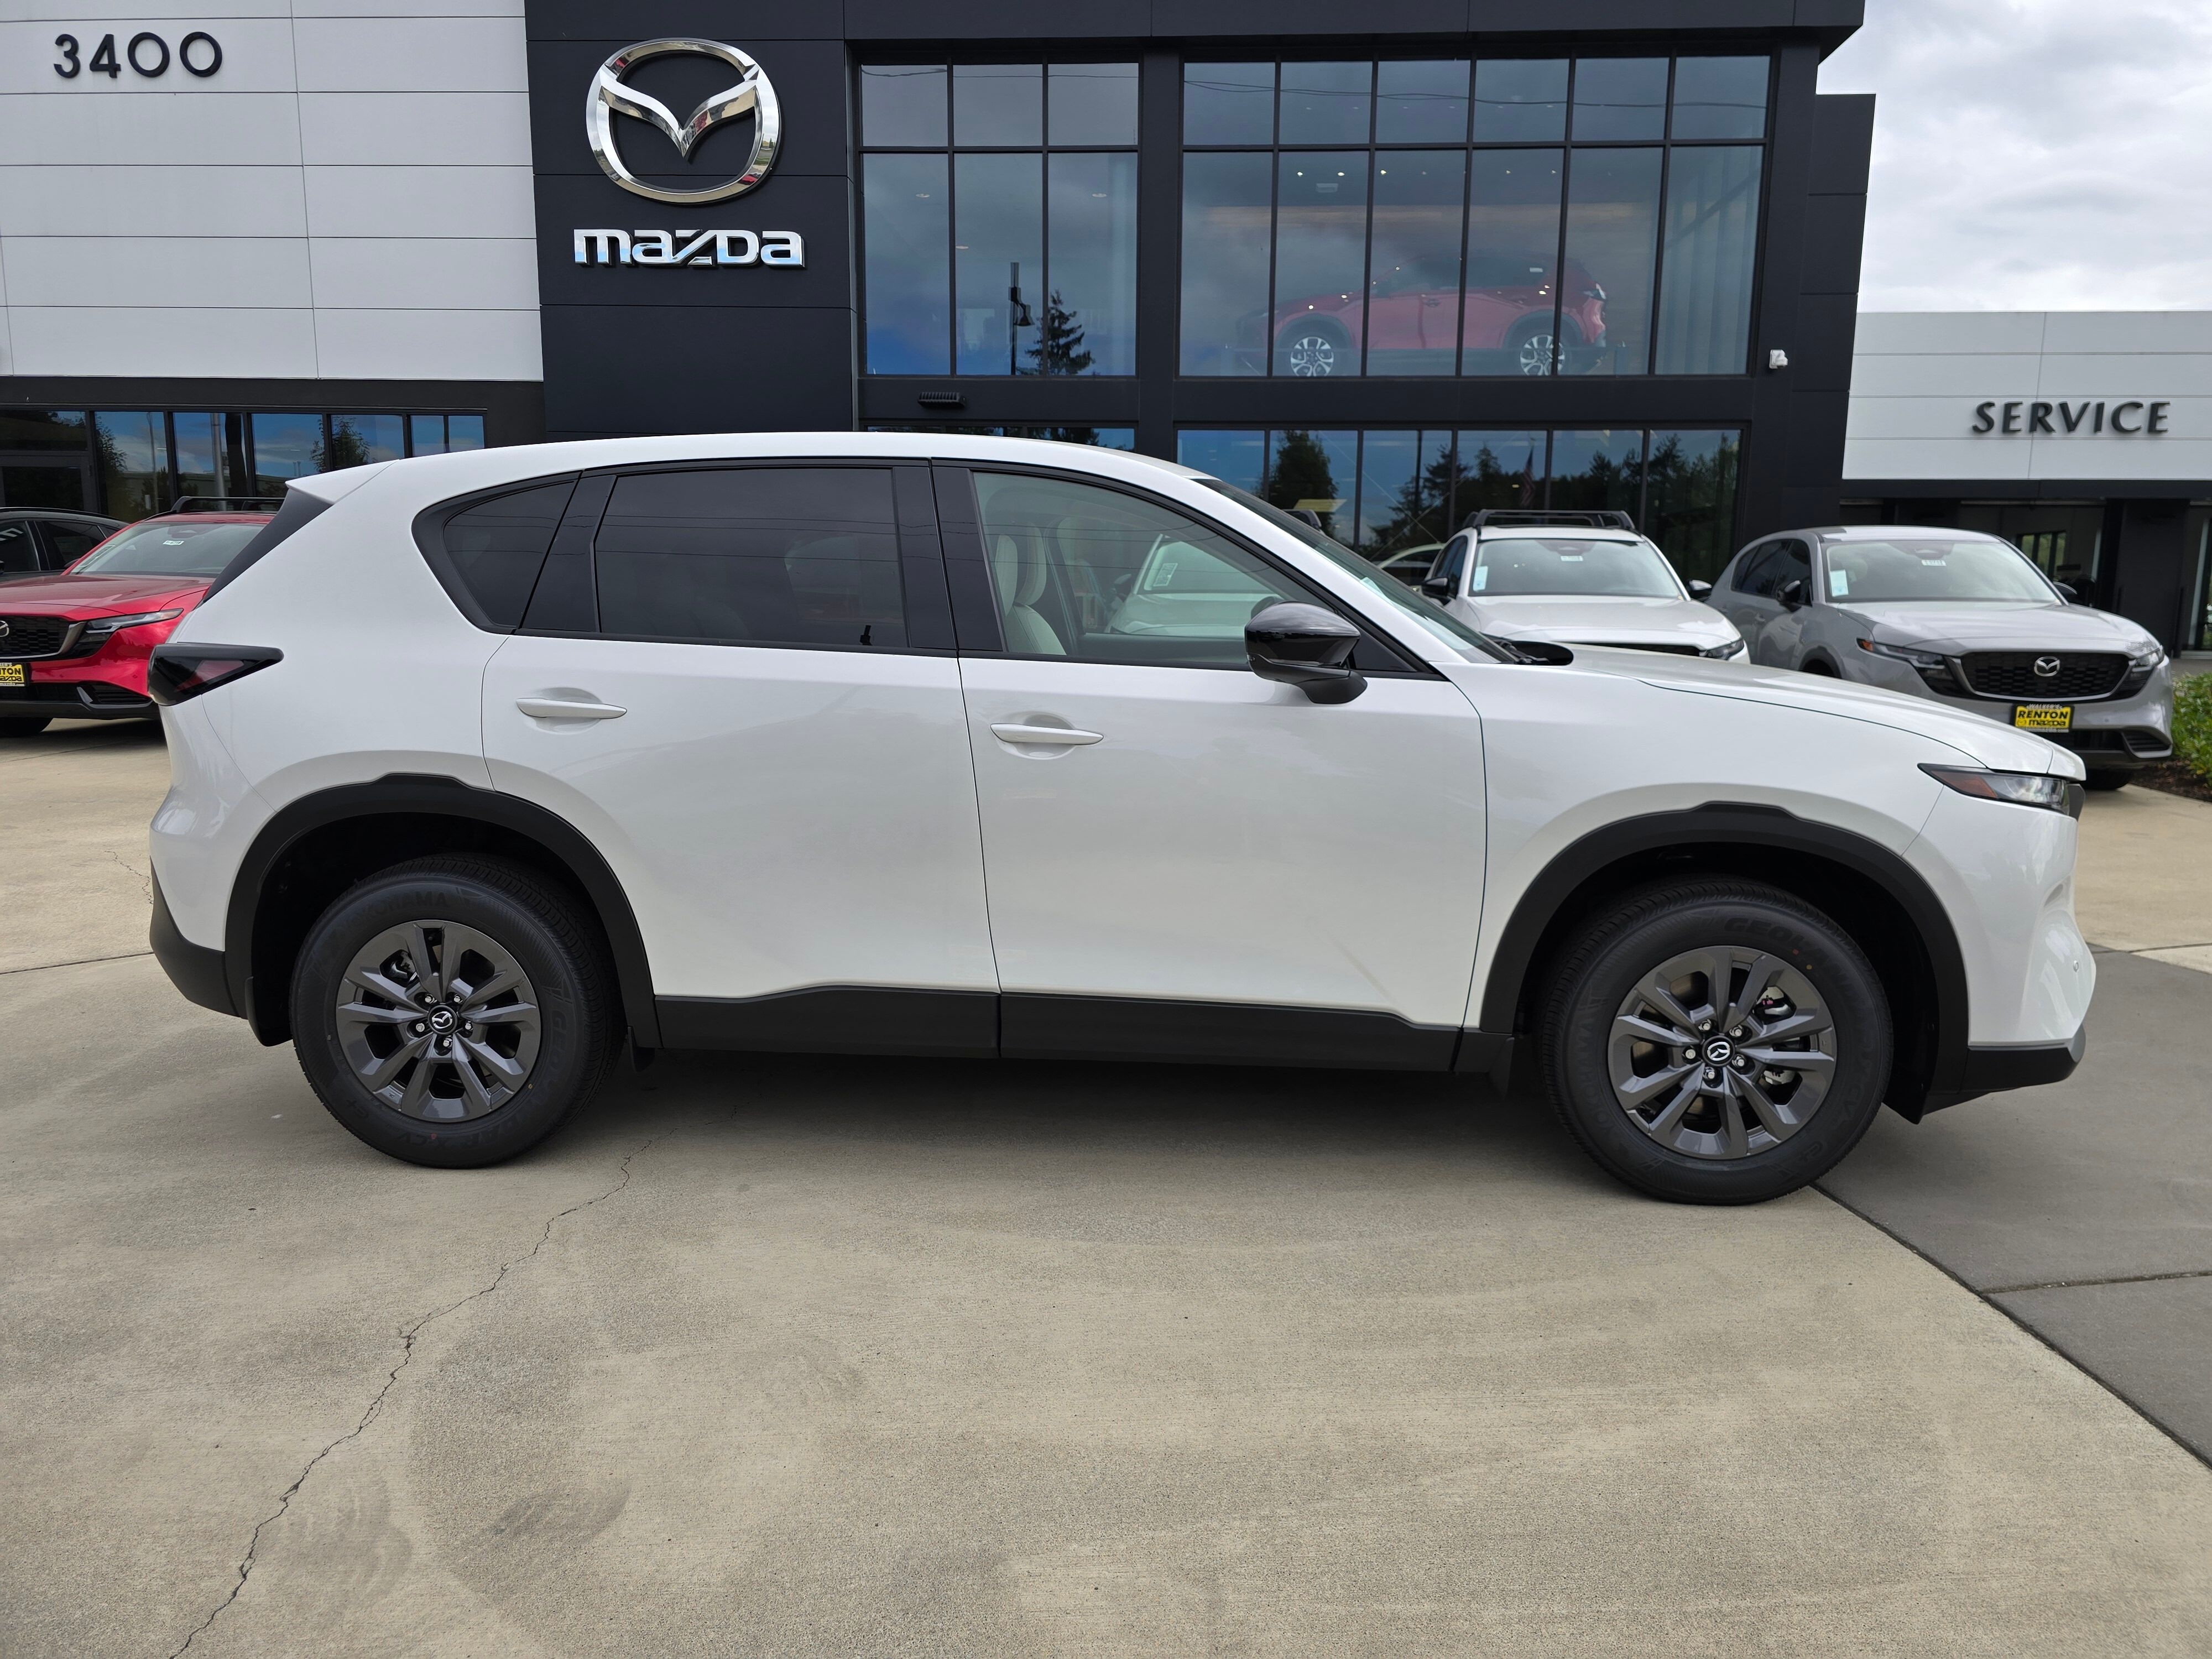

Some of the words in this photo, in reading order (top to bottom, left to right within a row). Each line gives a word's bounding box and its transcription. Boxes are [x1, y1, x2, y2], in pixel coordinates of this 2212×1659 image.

[54, 32, 222, 79] 3400
[1972, 401, 2170, 432] SERVICE
[2018, 711, 2068, 719] RENTON
